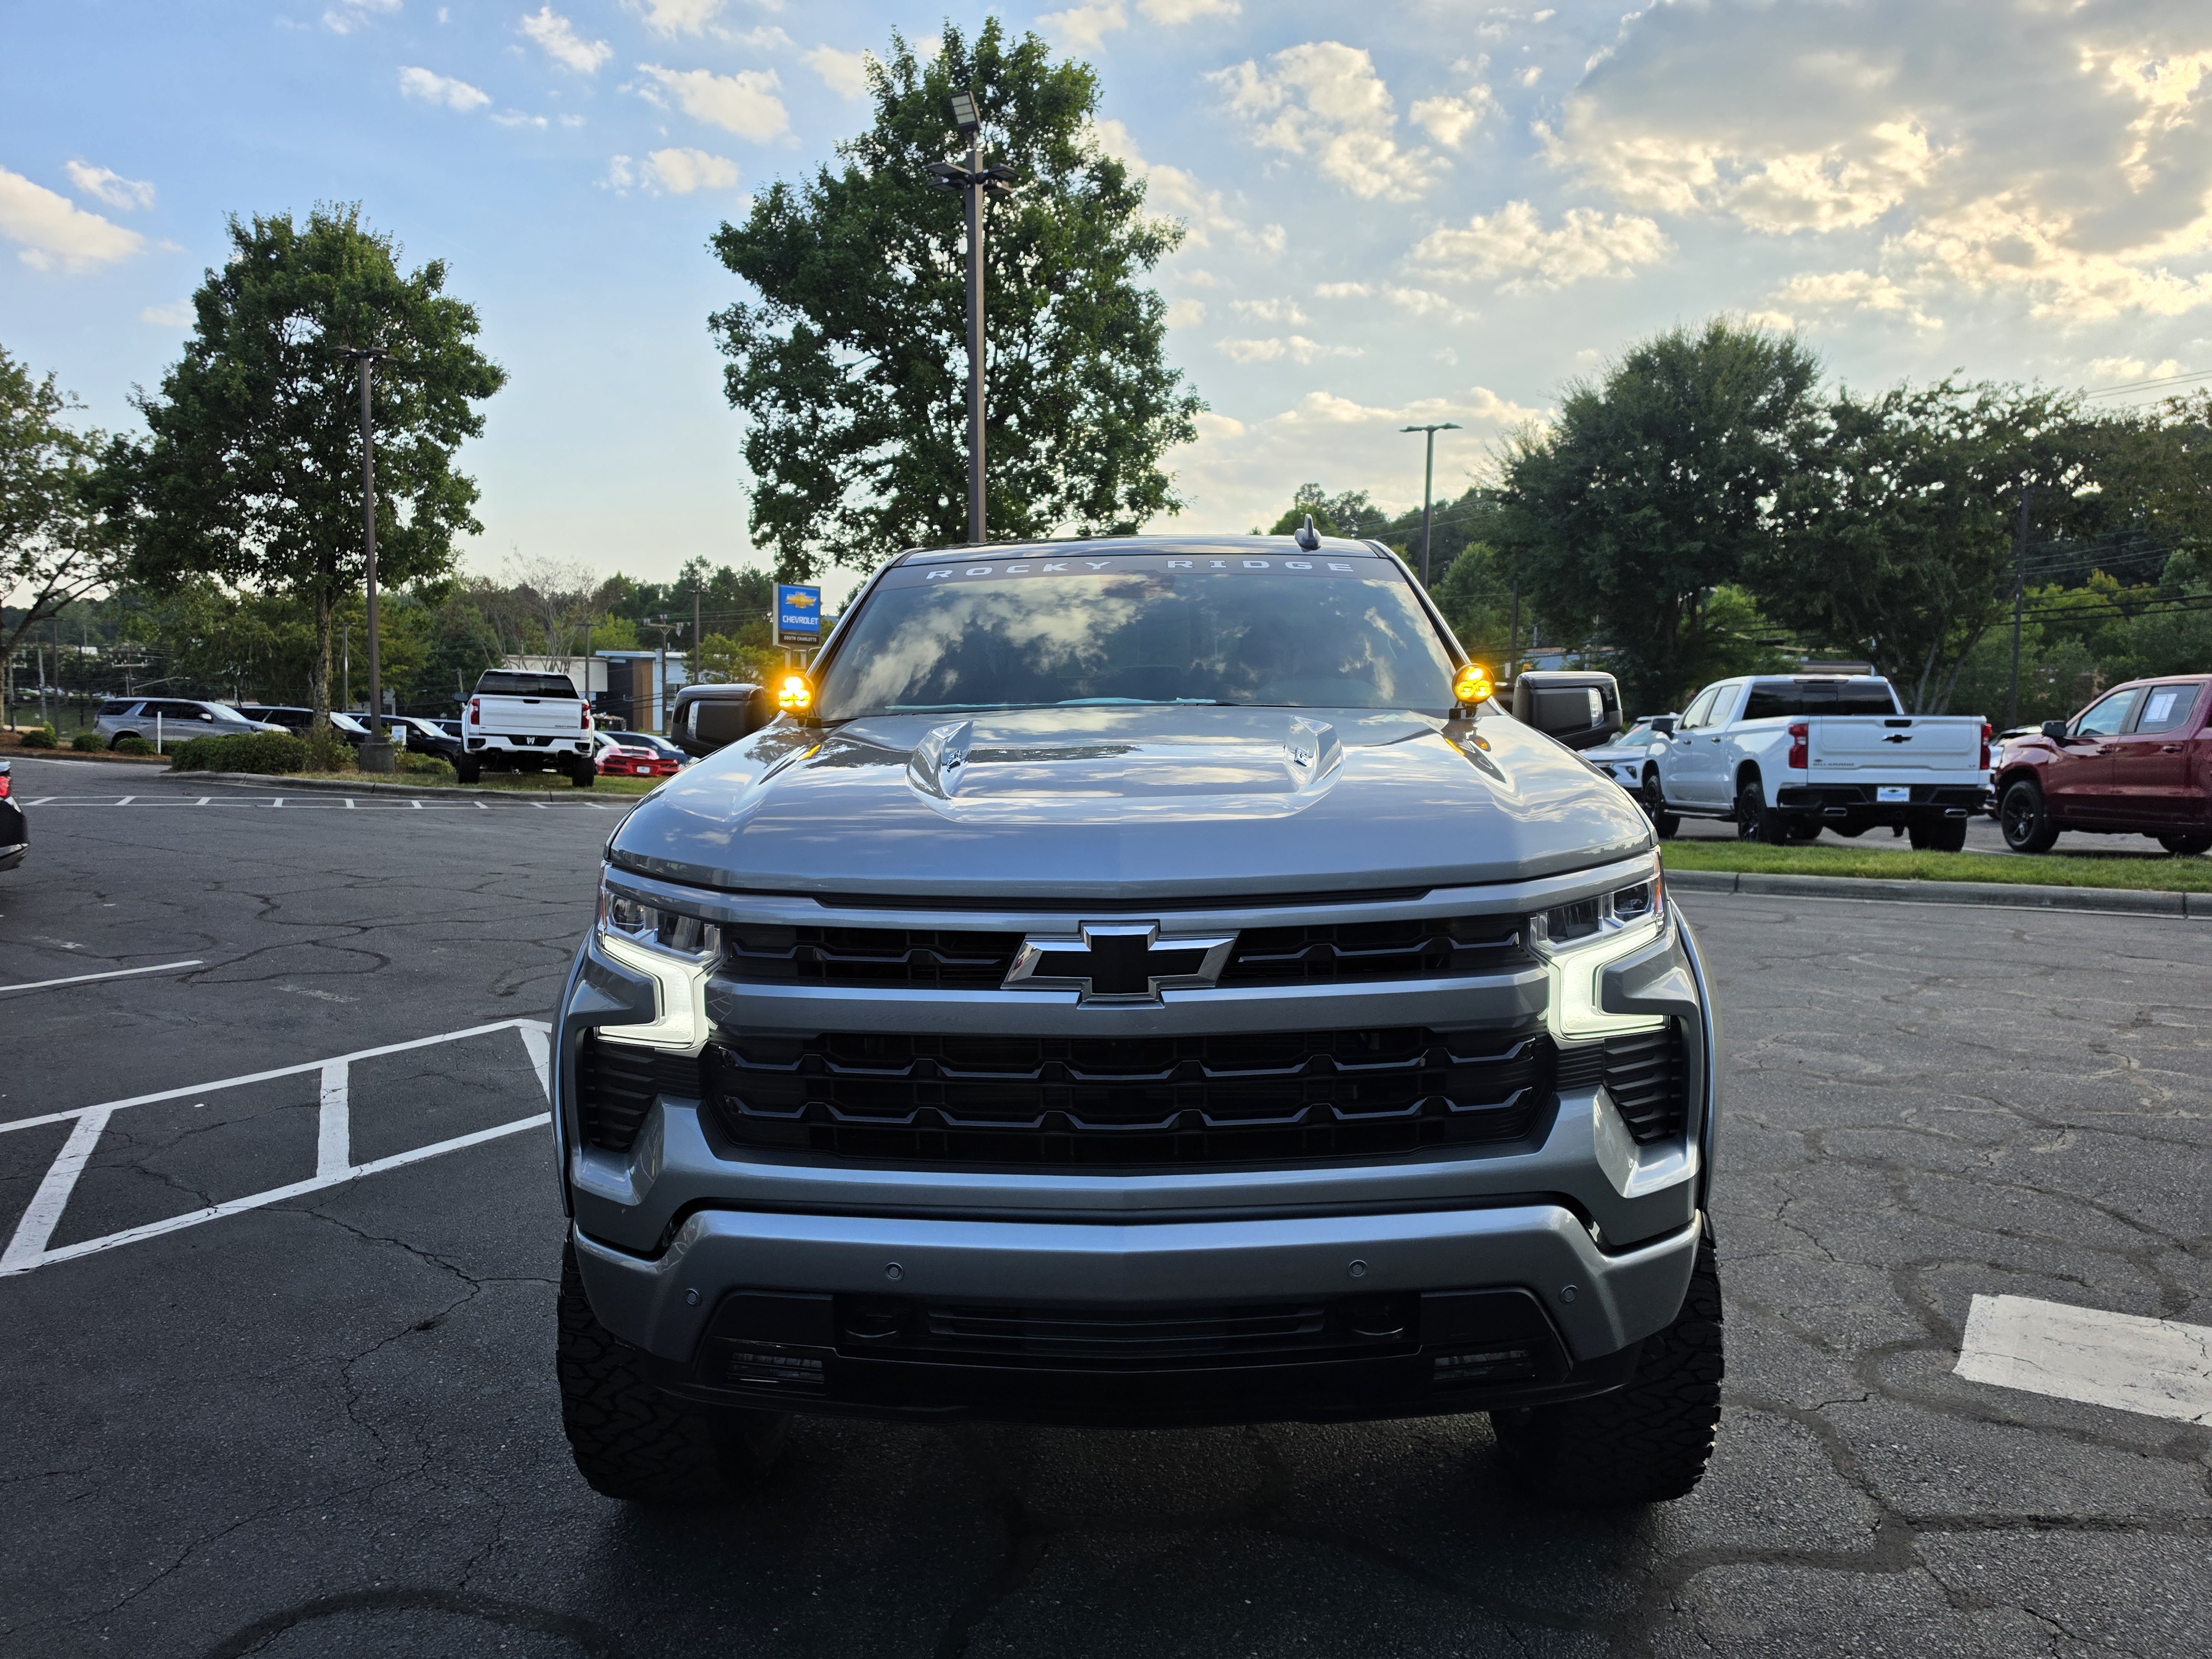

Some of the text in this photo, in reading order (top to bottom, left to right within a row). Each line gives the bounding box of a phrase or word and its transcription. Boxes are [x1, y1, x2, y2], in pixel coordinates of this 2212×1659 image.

[926, 560, 1354, 580] ROCKY RIDGE
[782, 615, 818, 625] CHEVROLET
